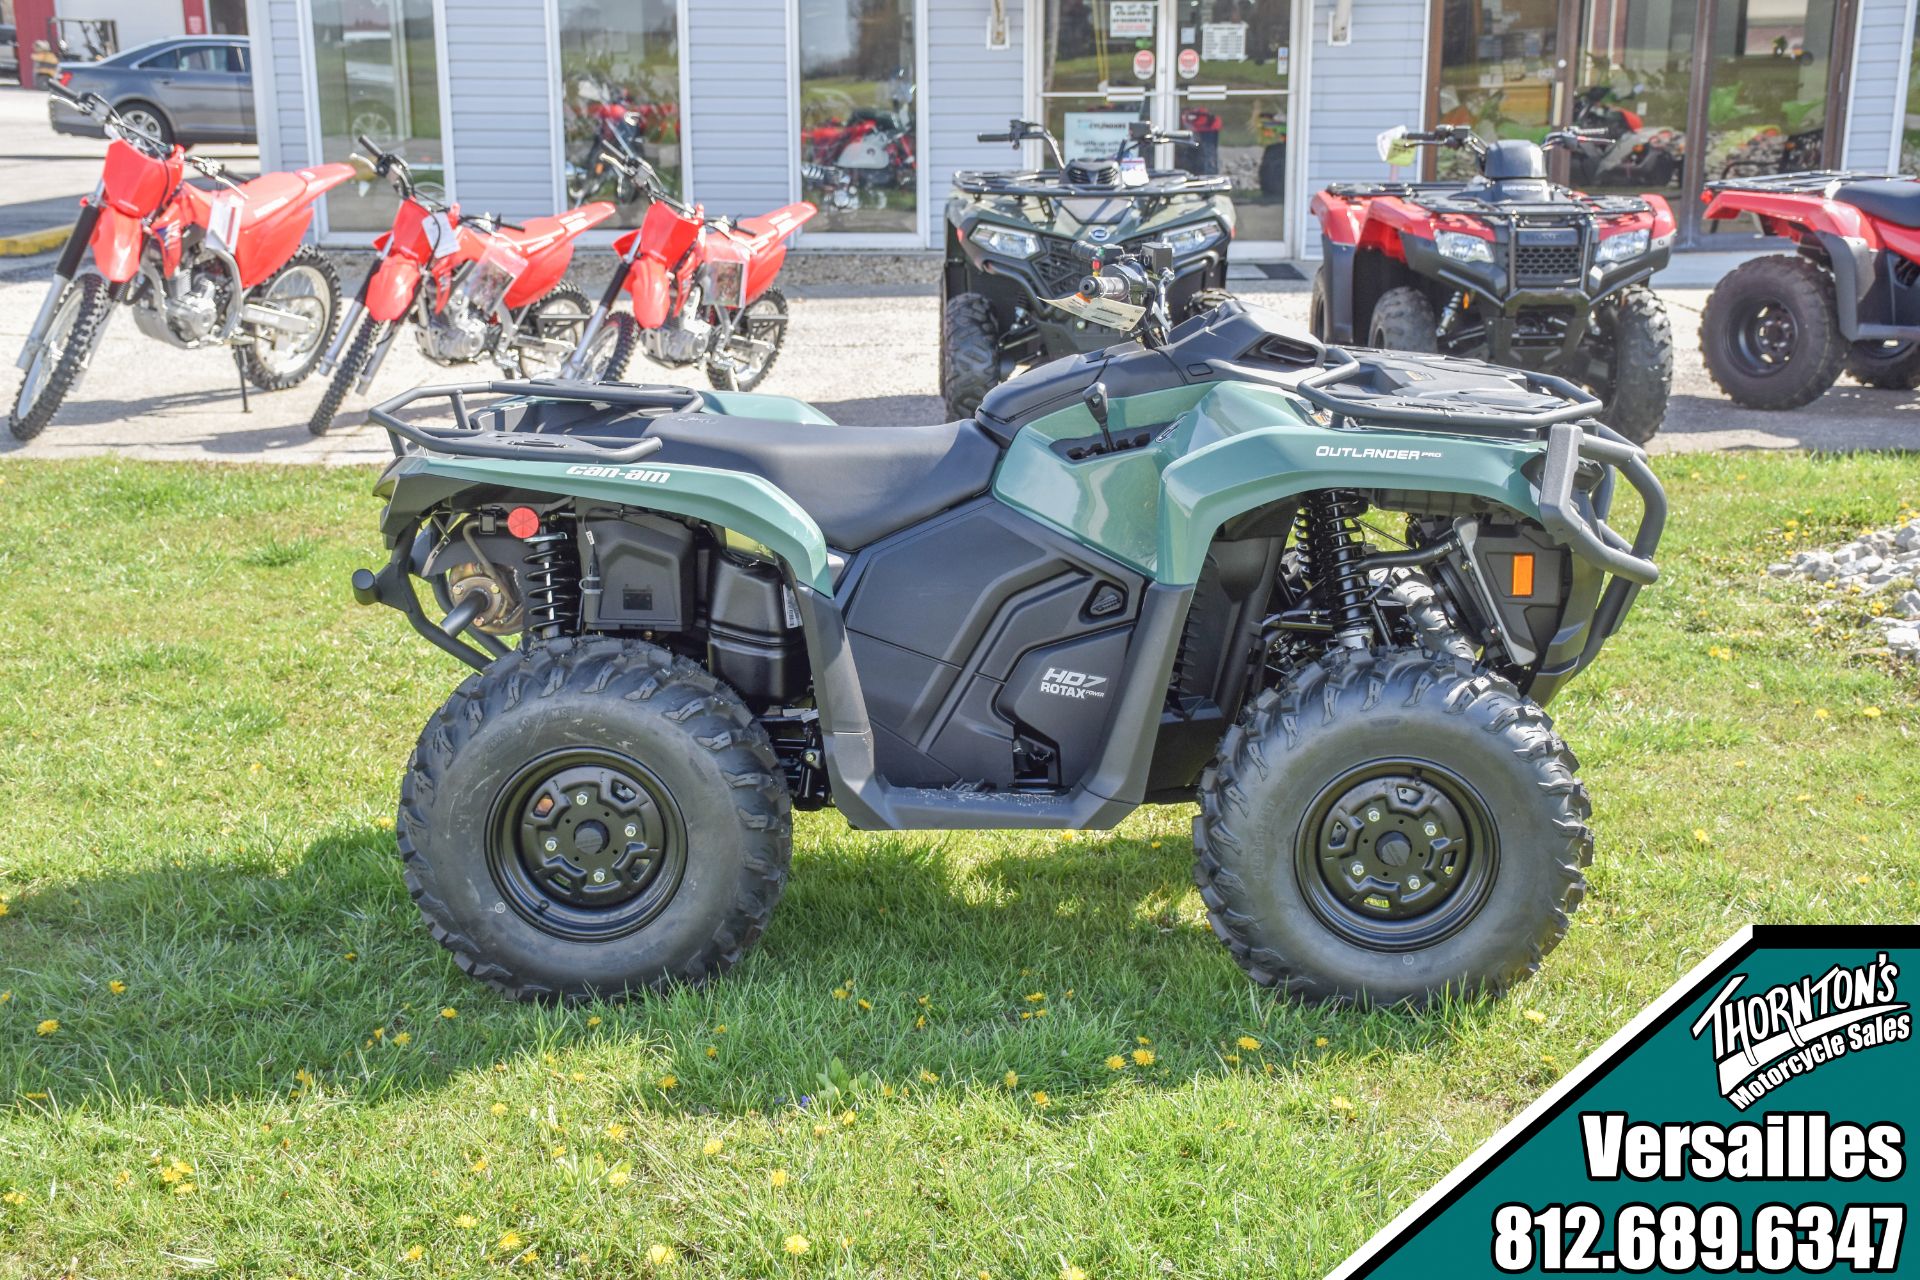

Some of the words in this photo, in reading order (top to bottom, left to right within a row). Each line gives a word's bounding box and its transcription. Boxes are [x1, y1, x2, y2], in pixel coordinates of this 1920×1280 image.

[1316, 446, 1420, 460] OUTLANDER
[566, 465, 671, 484] can-am
[1043, 667, 1107, 688] HD7
[1041, 681, 1086, 699] ROTAX
[1085, 689, 1105, 698] POWER
